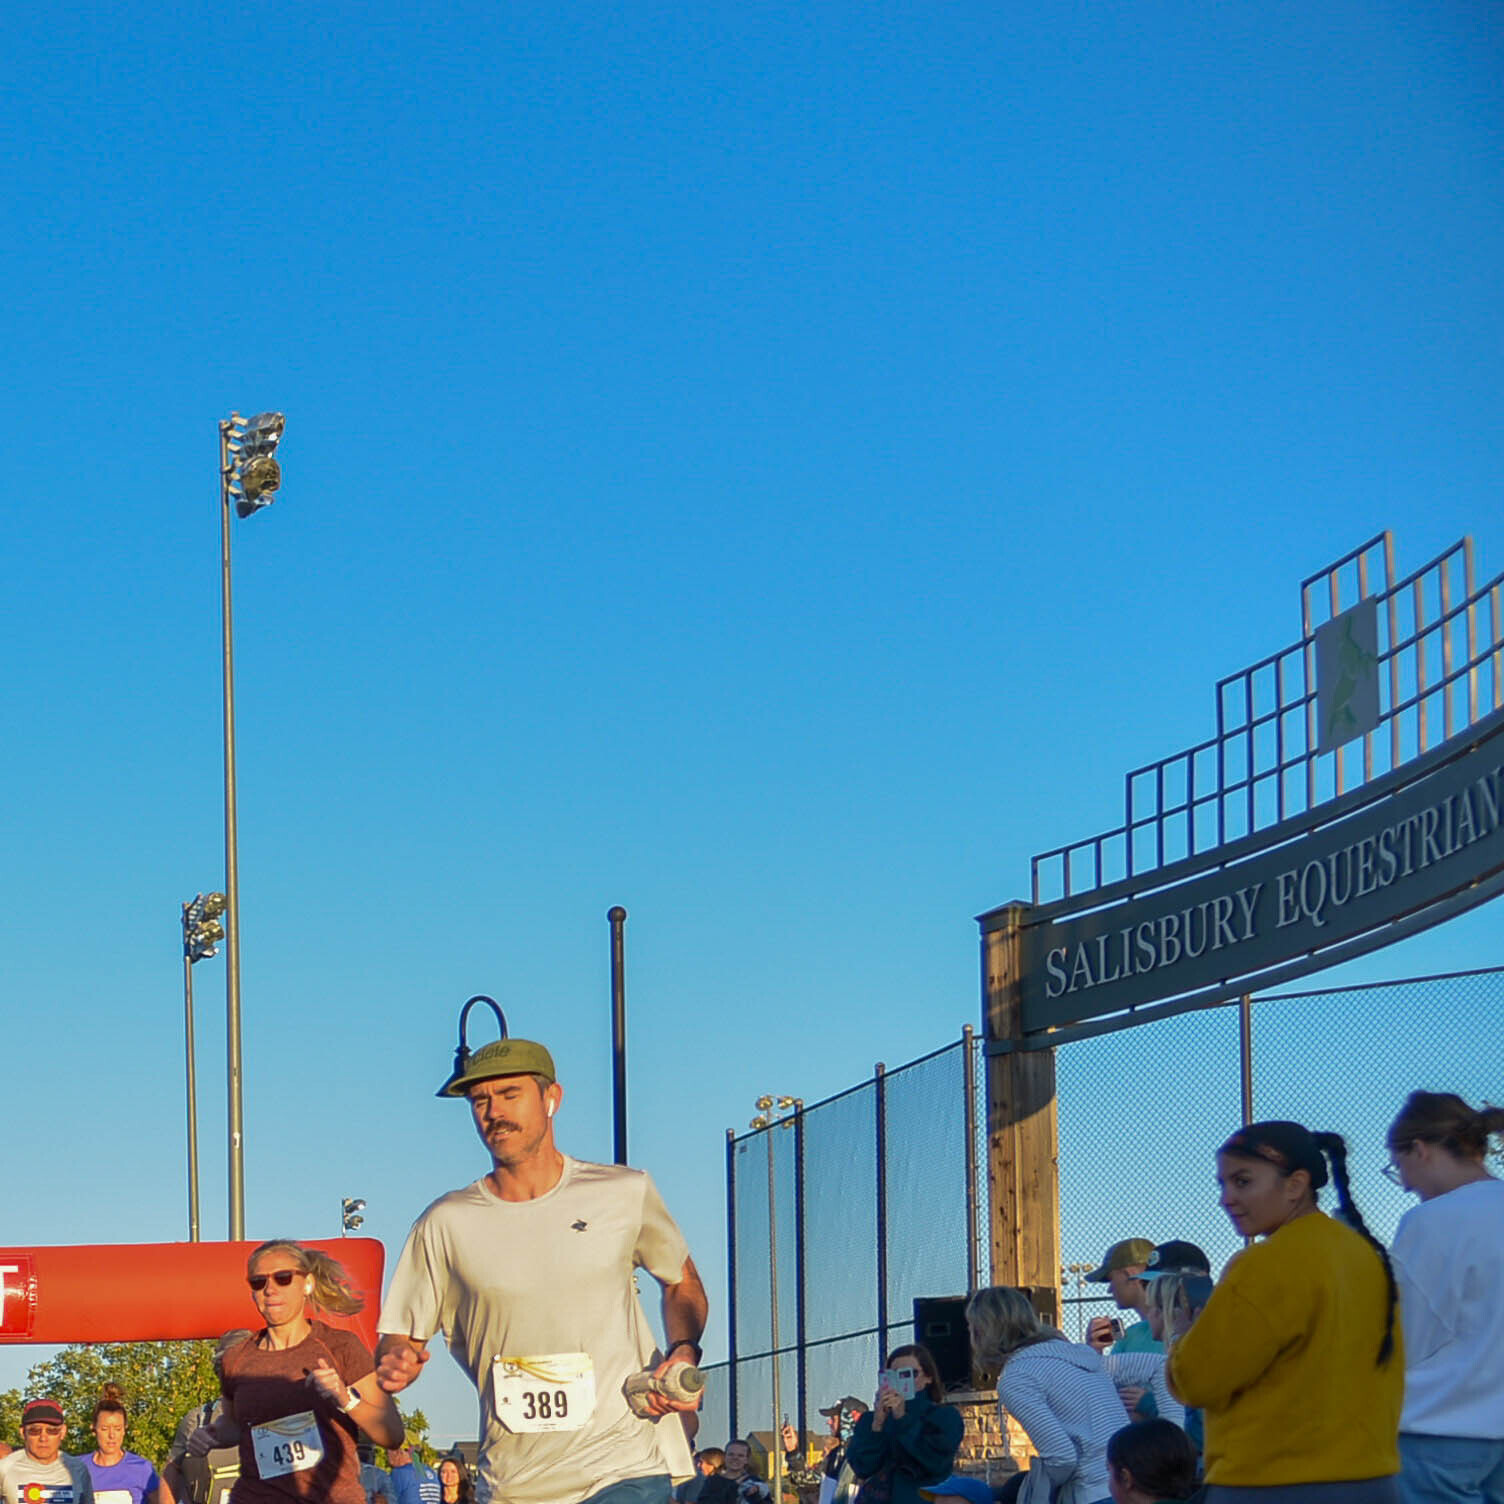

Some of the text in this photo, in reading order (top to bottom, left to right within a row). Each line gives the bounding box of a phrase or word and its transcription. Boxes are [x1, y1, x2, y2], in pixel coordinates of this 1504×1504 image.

[1045, 765, 1503, 998] SALISBURY EQUESTRIAN
[522, 1390, 568, 1420] 389
[273, 1440, 306, 1466] 439
